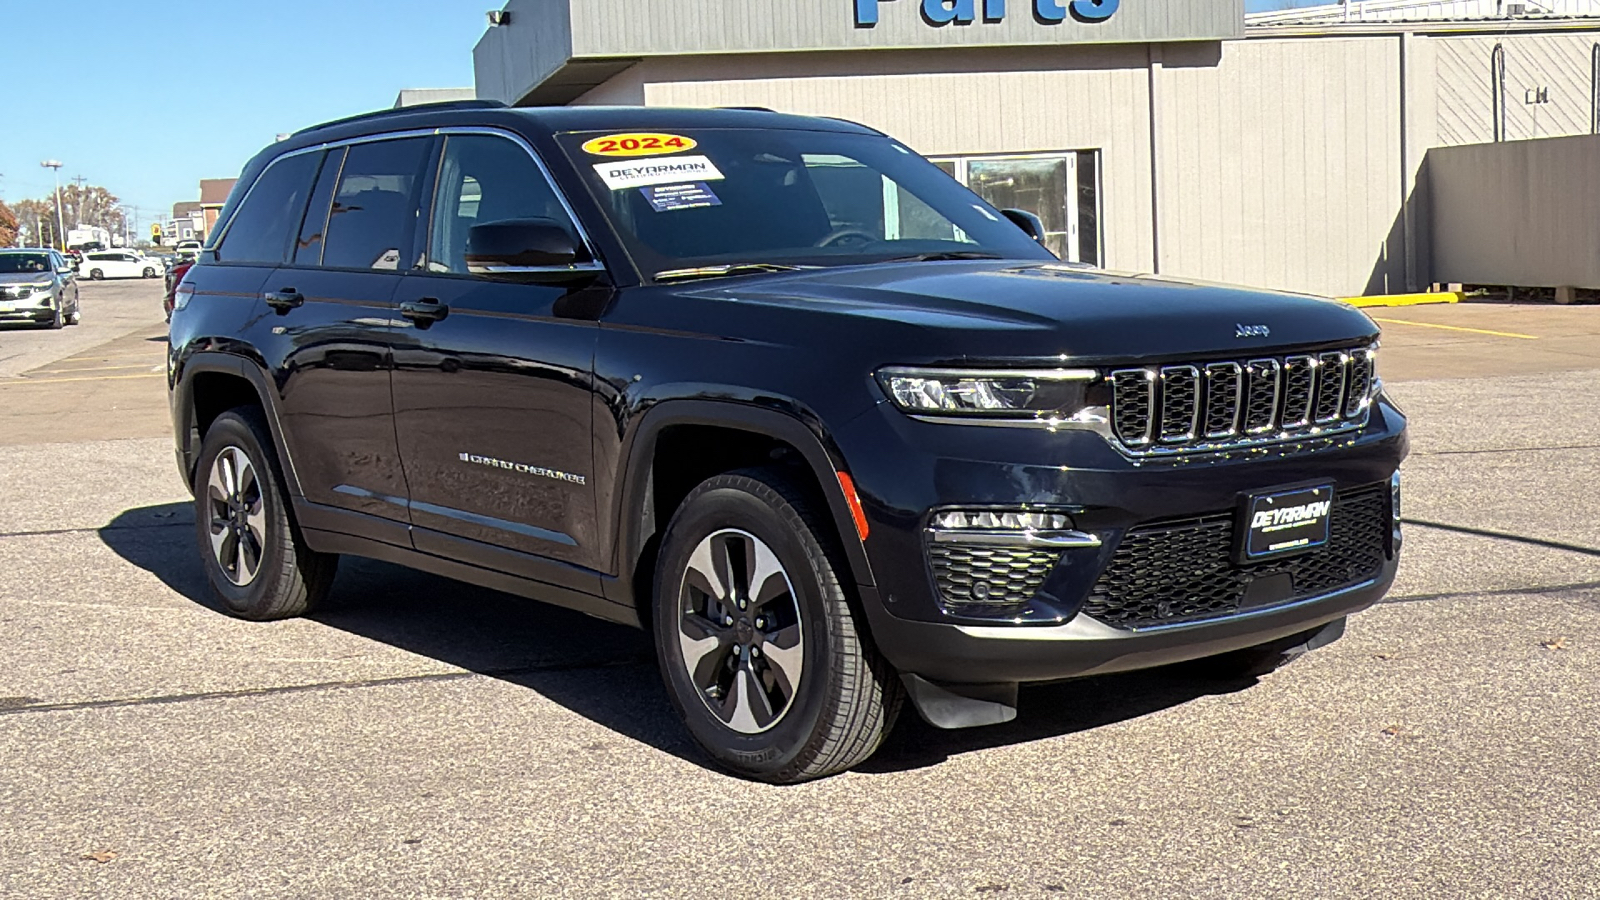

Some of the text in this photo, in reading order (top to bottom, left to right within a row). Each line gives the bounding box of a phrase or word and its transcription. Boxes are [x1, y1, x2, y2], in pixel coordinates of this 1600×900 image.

[597, 137, 686, 152] 2024
[609, 163, 706, 178] DEYARMAN
[1235, 323, 1270, 337] Jeep
[470, 455, 586, 485] GRAND CHEROKEE
[1251, 501, 1330, 528] DEYARMAN
